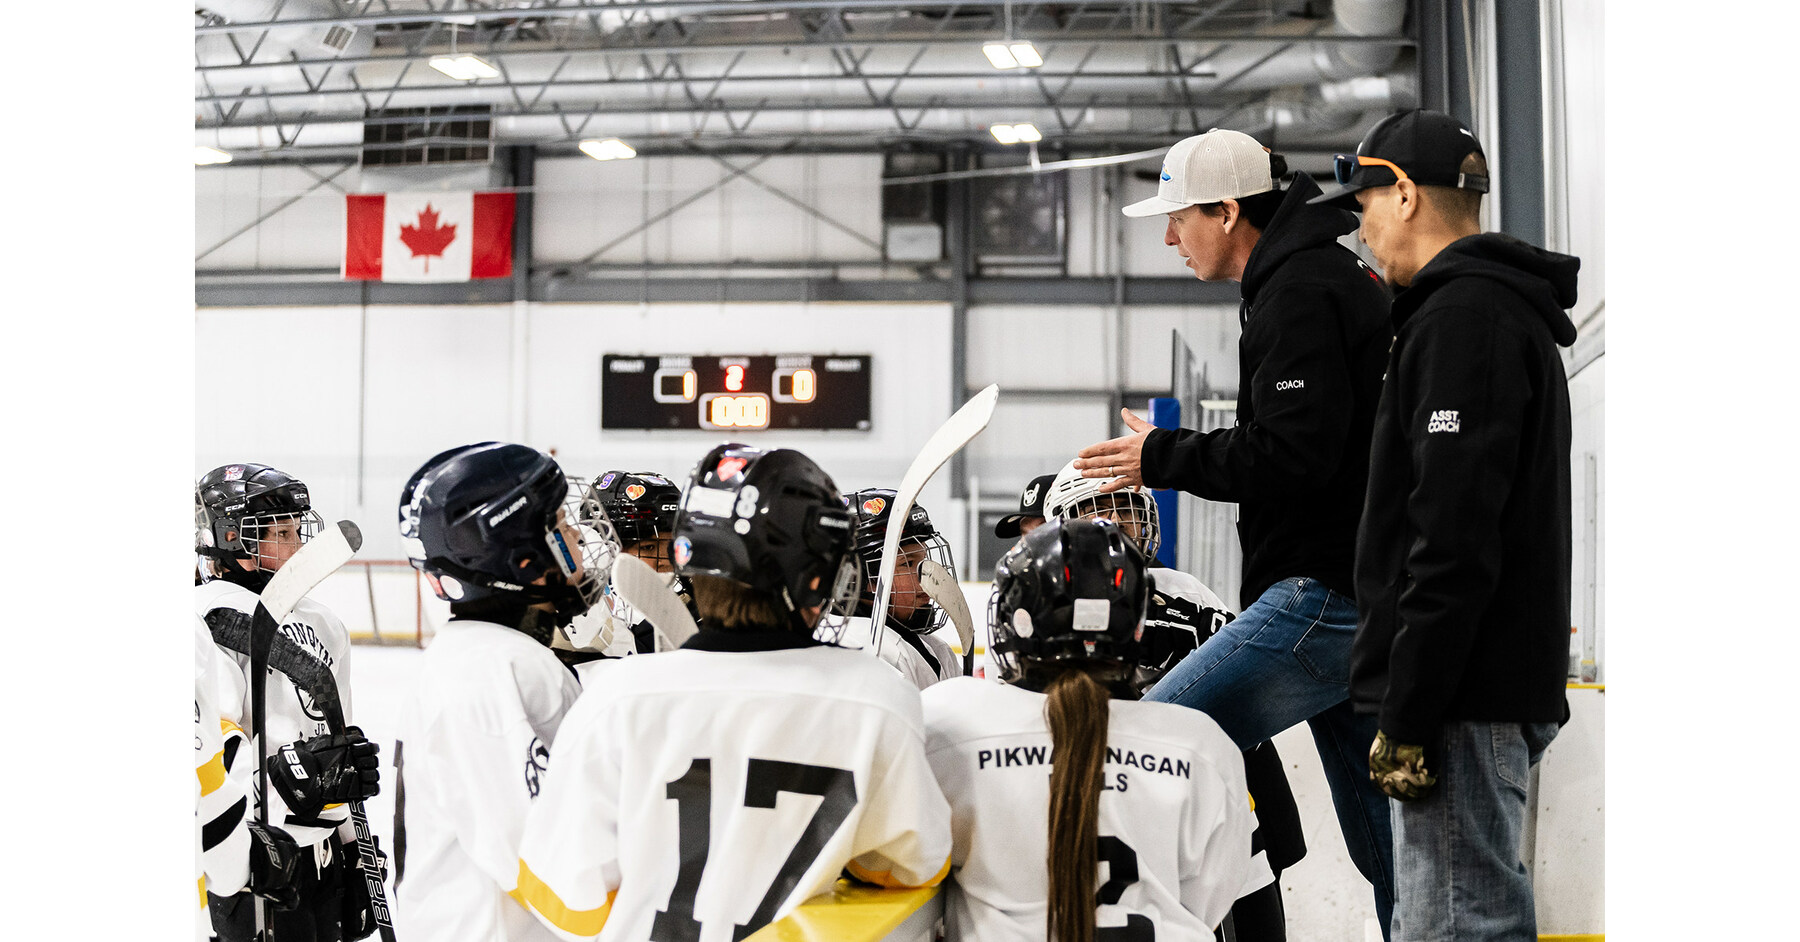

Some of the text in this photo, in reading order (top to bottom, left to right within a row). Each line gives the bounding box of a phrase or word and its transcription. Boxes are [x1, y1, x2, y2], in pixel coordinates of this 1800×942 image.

[683, 371, 695, 400] 1
[725, 365, 744, 391] 2
[792, 370, 814, 401] 0
[1276, 380, 1304, 391] COACH
[1428, 421, 1460, 433] COACH
[225, 503, 246, 512] CCM
[911, 511, 927, 521] CCM
[979, 746, 1190, 779] PIKWNAGAN
[649, 758, 858, 942] 17
